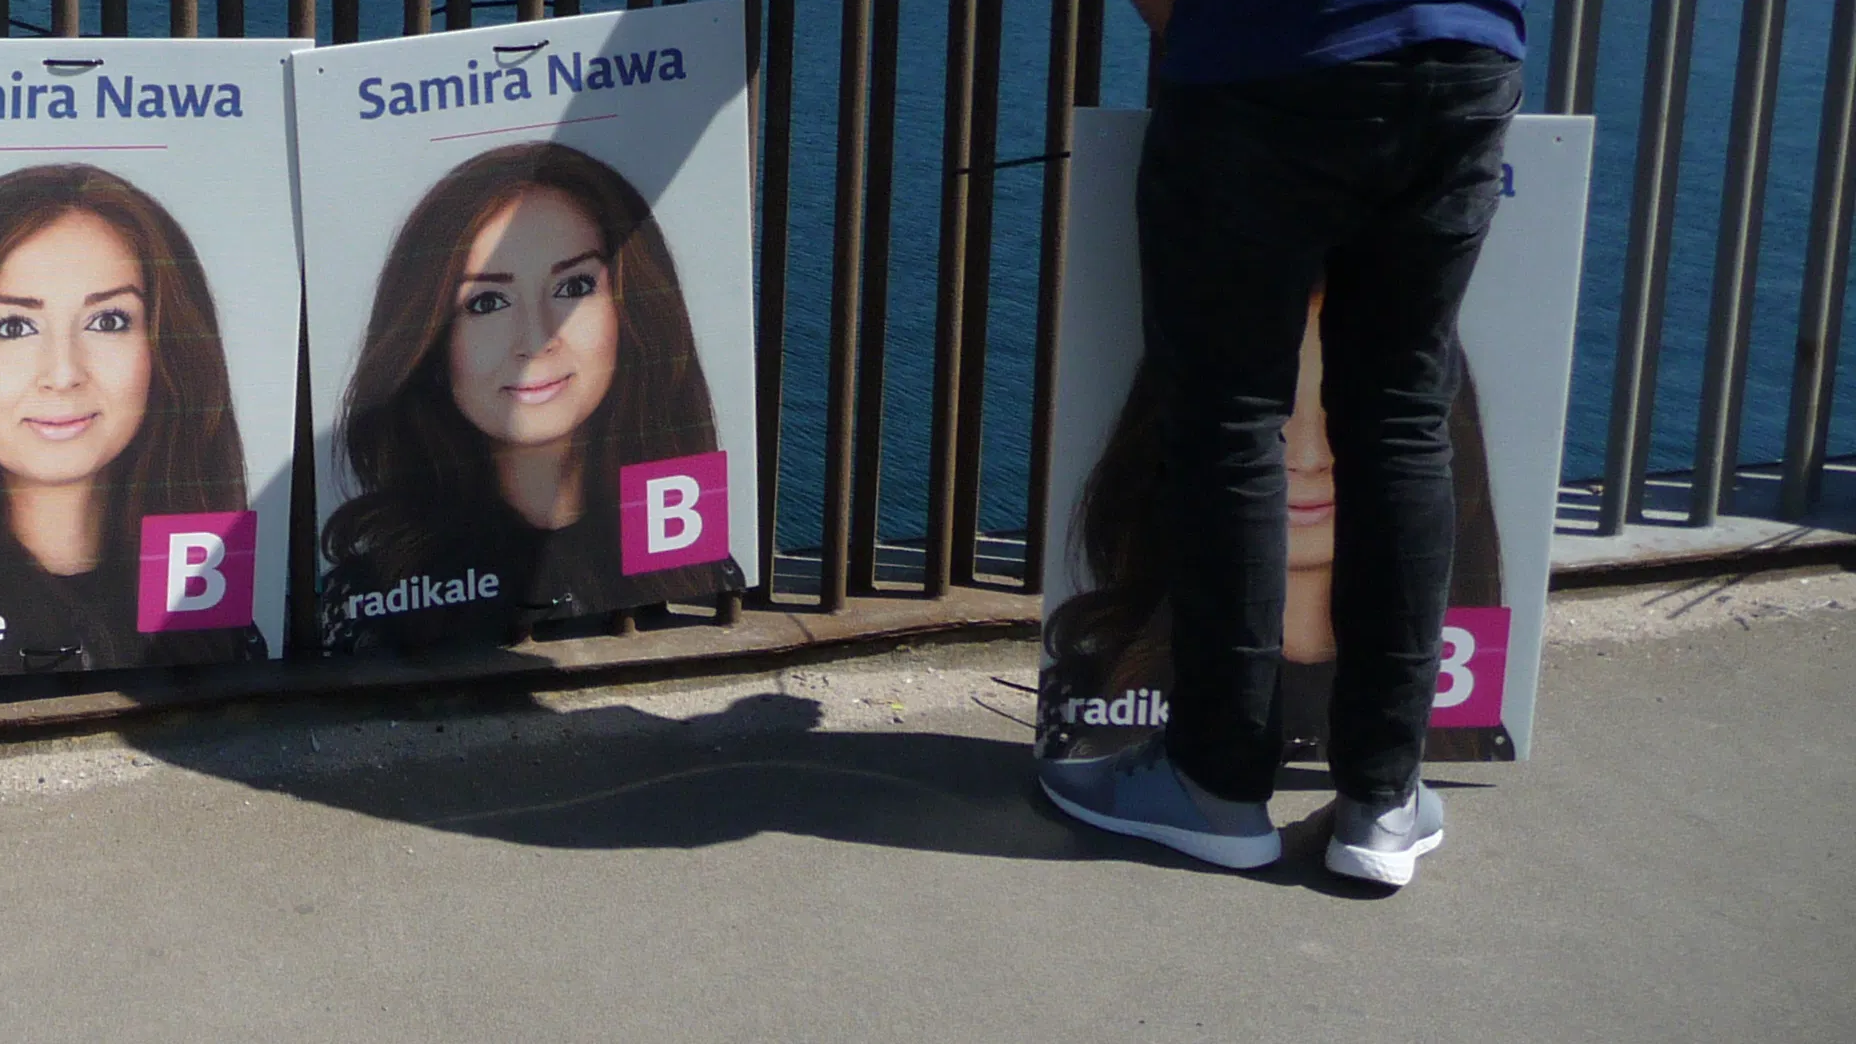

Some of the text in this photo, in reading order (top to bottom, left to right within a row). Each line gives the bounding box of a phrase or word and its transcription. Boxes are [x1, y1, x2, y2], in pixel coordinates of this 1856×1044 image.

[95, 75, 243, 119] Nawa
[358, 47, 686, 120] Samira Nawa
[645, 474, 704, 554] B
[166, 531, 227, 612] B
[347, 567, 500, 620] radikale
[1065, 688, 1171, 727] radik
